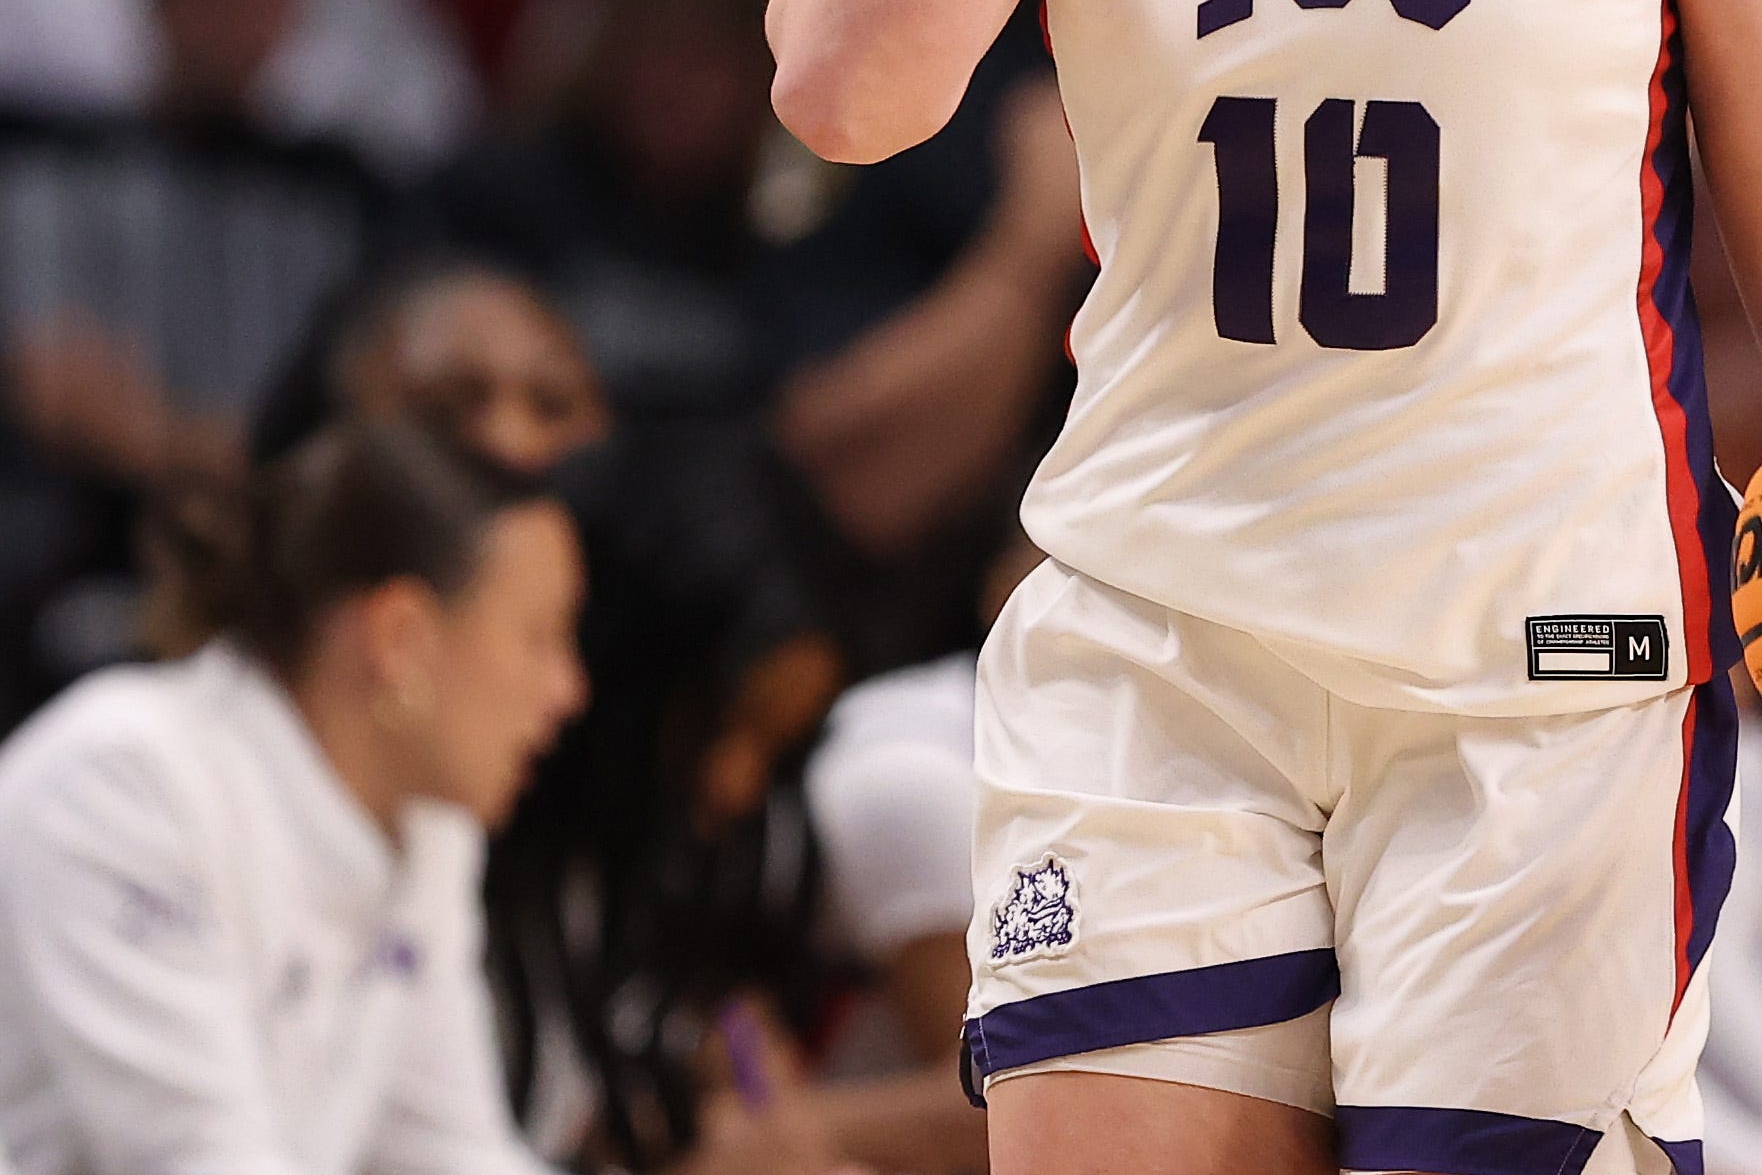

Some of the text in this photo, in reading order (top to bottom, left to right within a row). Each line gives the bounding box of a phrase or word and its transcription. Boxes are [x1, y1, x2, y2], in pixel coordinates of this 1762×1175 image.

[1197, 95, 1443, 351] 10
[1536, 625, 1610, 634] ENGINEERED
[1628, 636, 1650, 661] M
